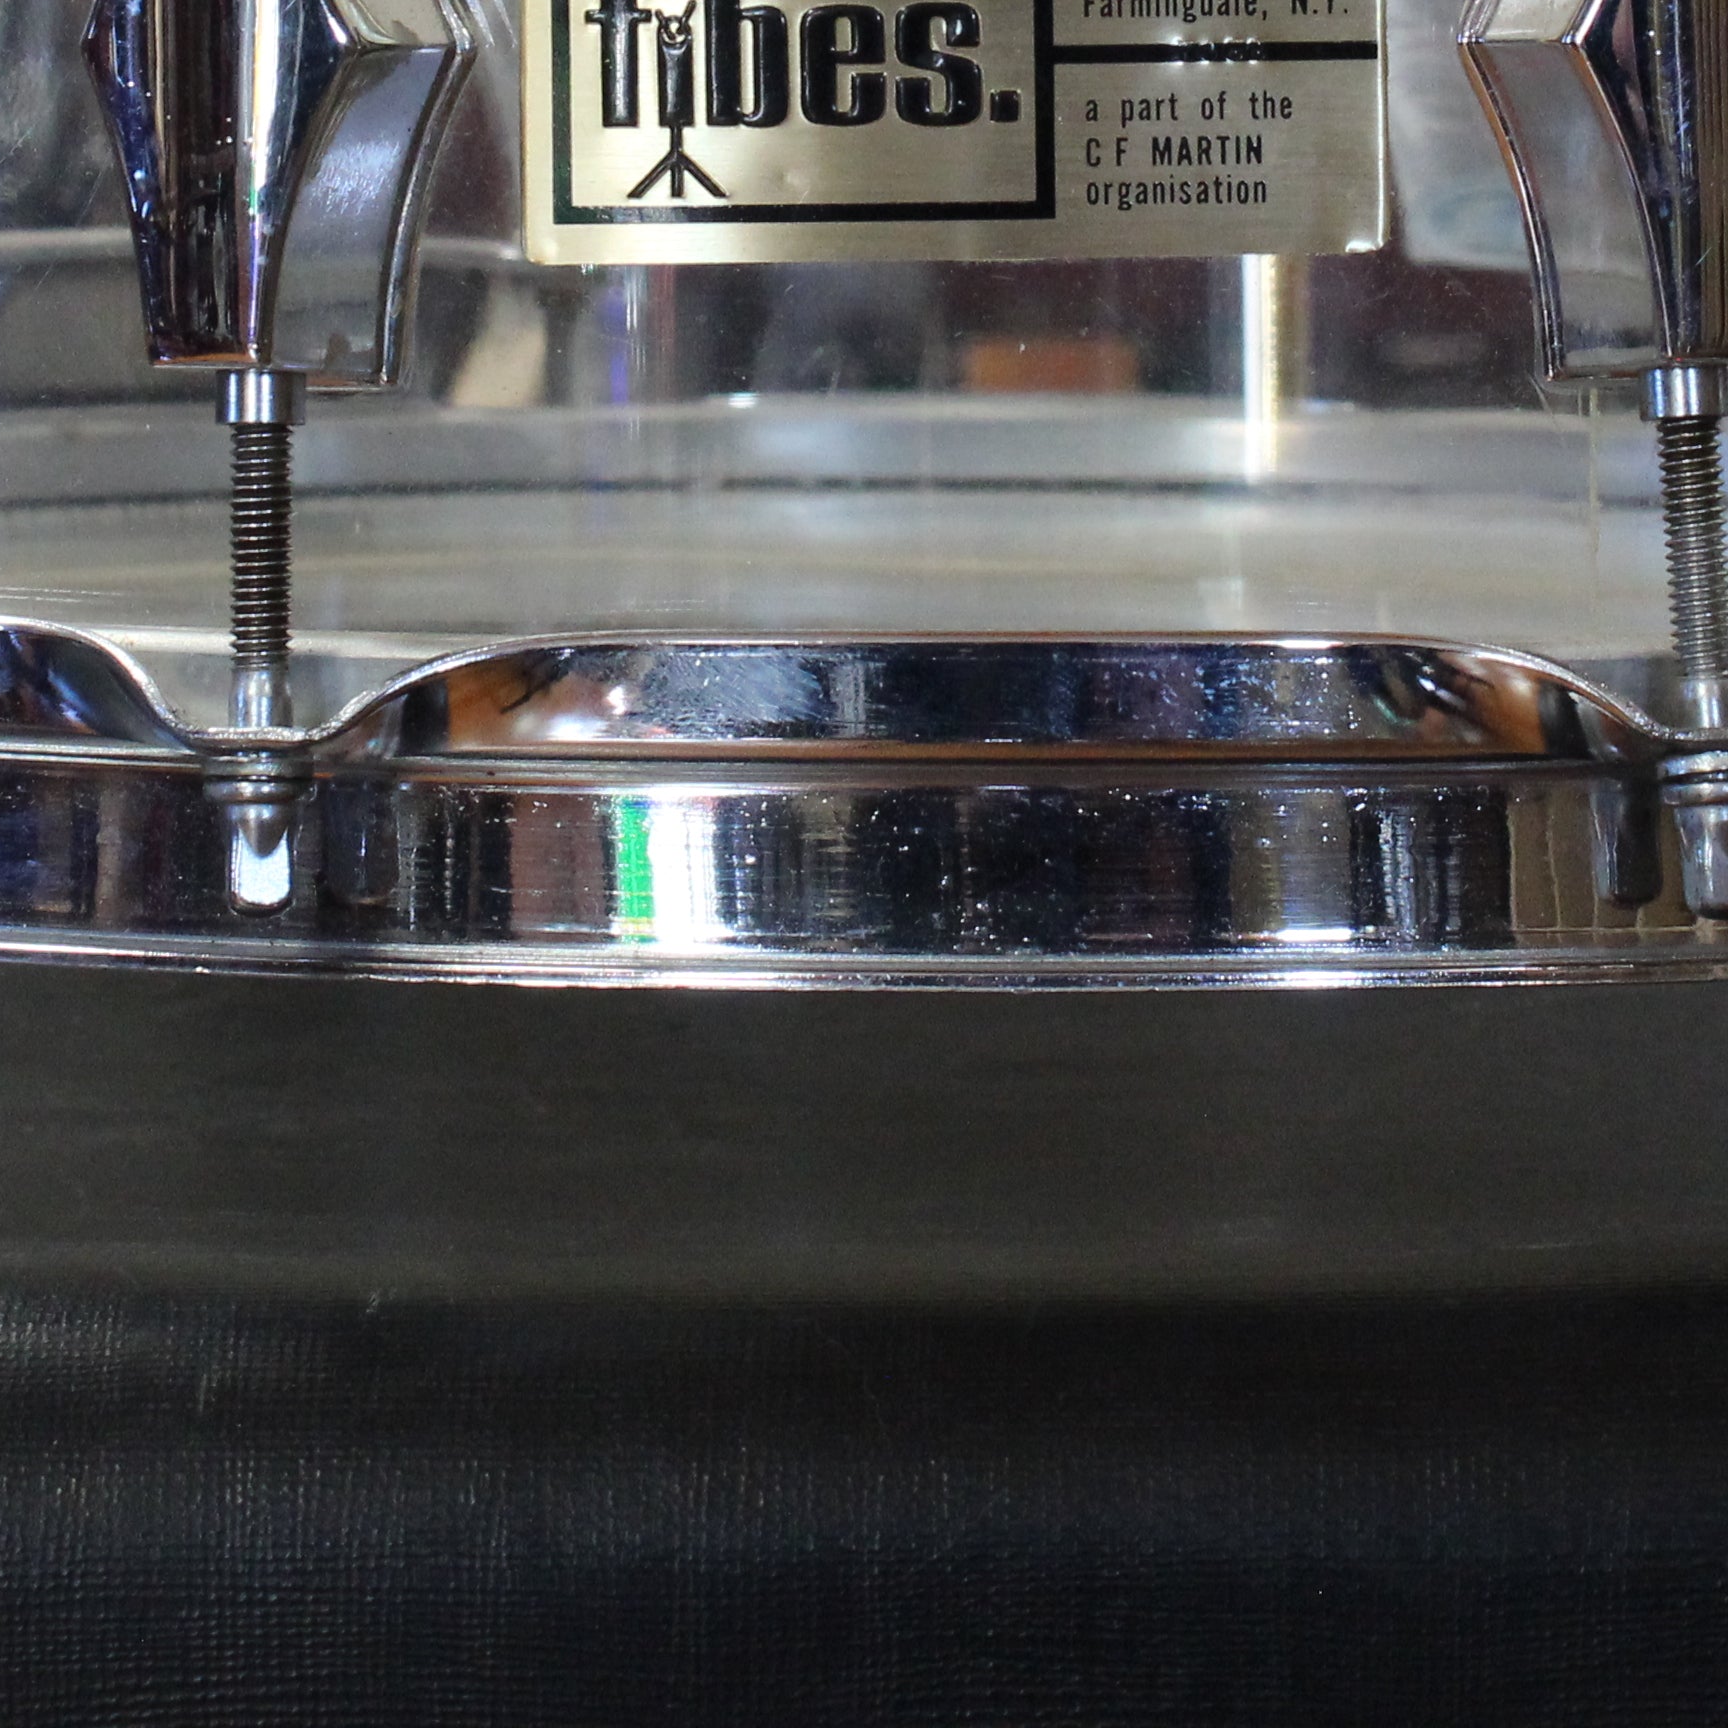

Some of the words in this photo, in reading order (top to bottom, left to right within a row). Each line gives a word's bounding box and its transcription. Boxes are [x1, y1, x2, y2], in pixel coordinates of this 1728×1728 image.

[1084, 98, 1099, 123] a
[1120, 92, 1179, 129] part
[1200, 90, 1227, 121] of
[1248, 89, 1294, 121] the
[1085, 137, 1101, 167] C
[1115, 136, 1129, 167] F
[1151, 134, 1264, 167] MARTIN
[1085, 173, 1268, 212] organisation
